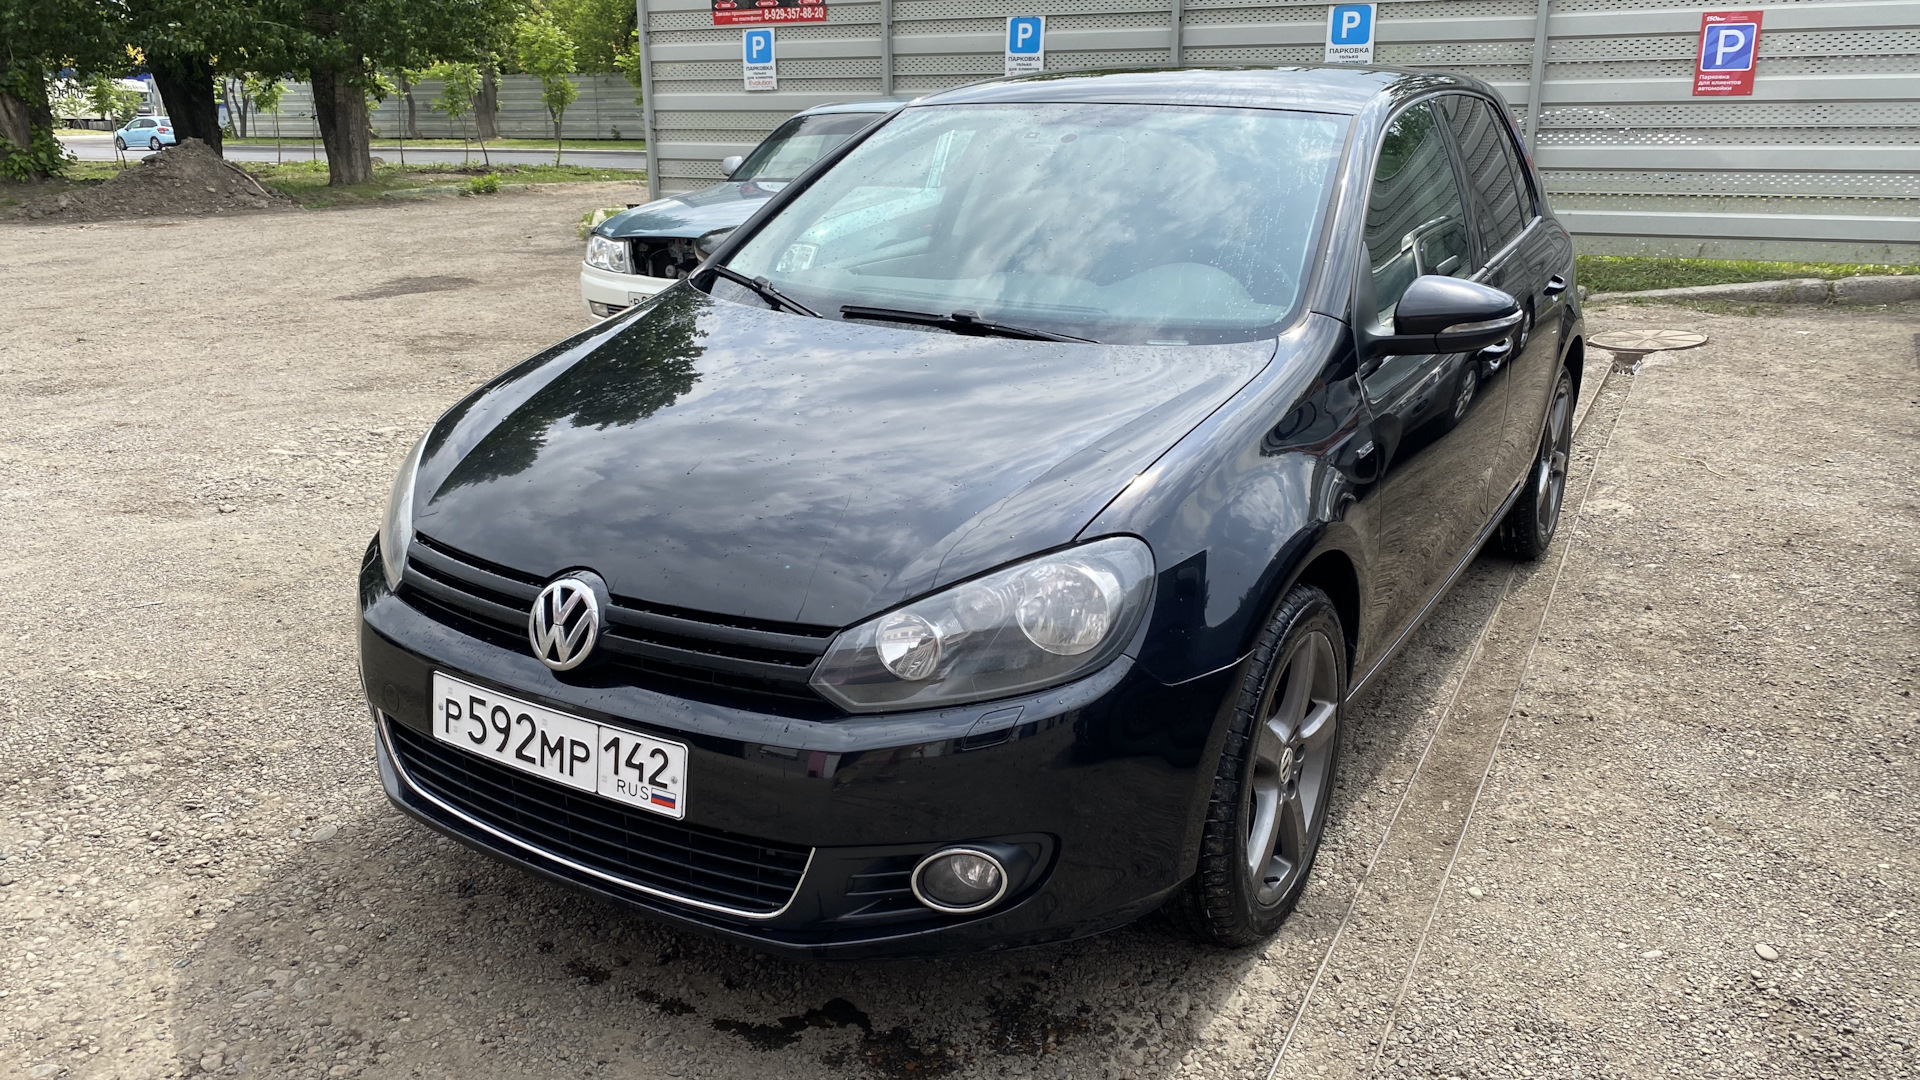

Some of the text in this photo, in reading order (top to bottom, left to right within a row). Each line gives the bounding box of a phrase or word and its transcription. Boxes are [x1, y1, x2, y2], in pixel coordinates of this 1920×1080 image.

[764, 6, 824, 20] 8-929-357-88-20
[1341, 11, 1361, 39] P
[752, 35, 765, 59] P
[1017, 22, 1033, 48] P
[1716, 29, 1745, 66] P
[603, 736, 669, 789] 142
[616, 779, 649, 800] RUS
